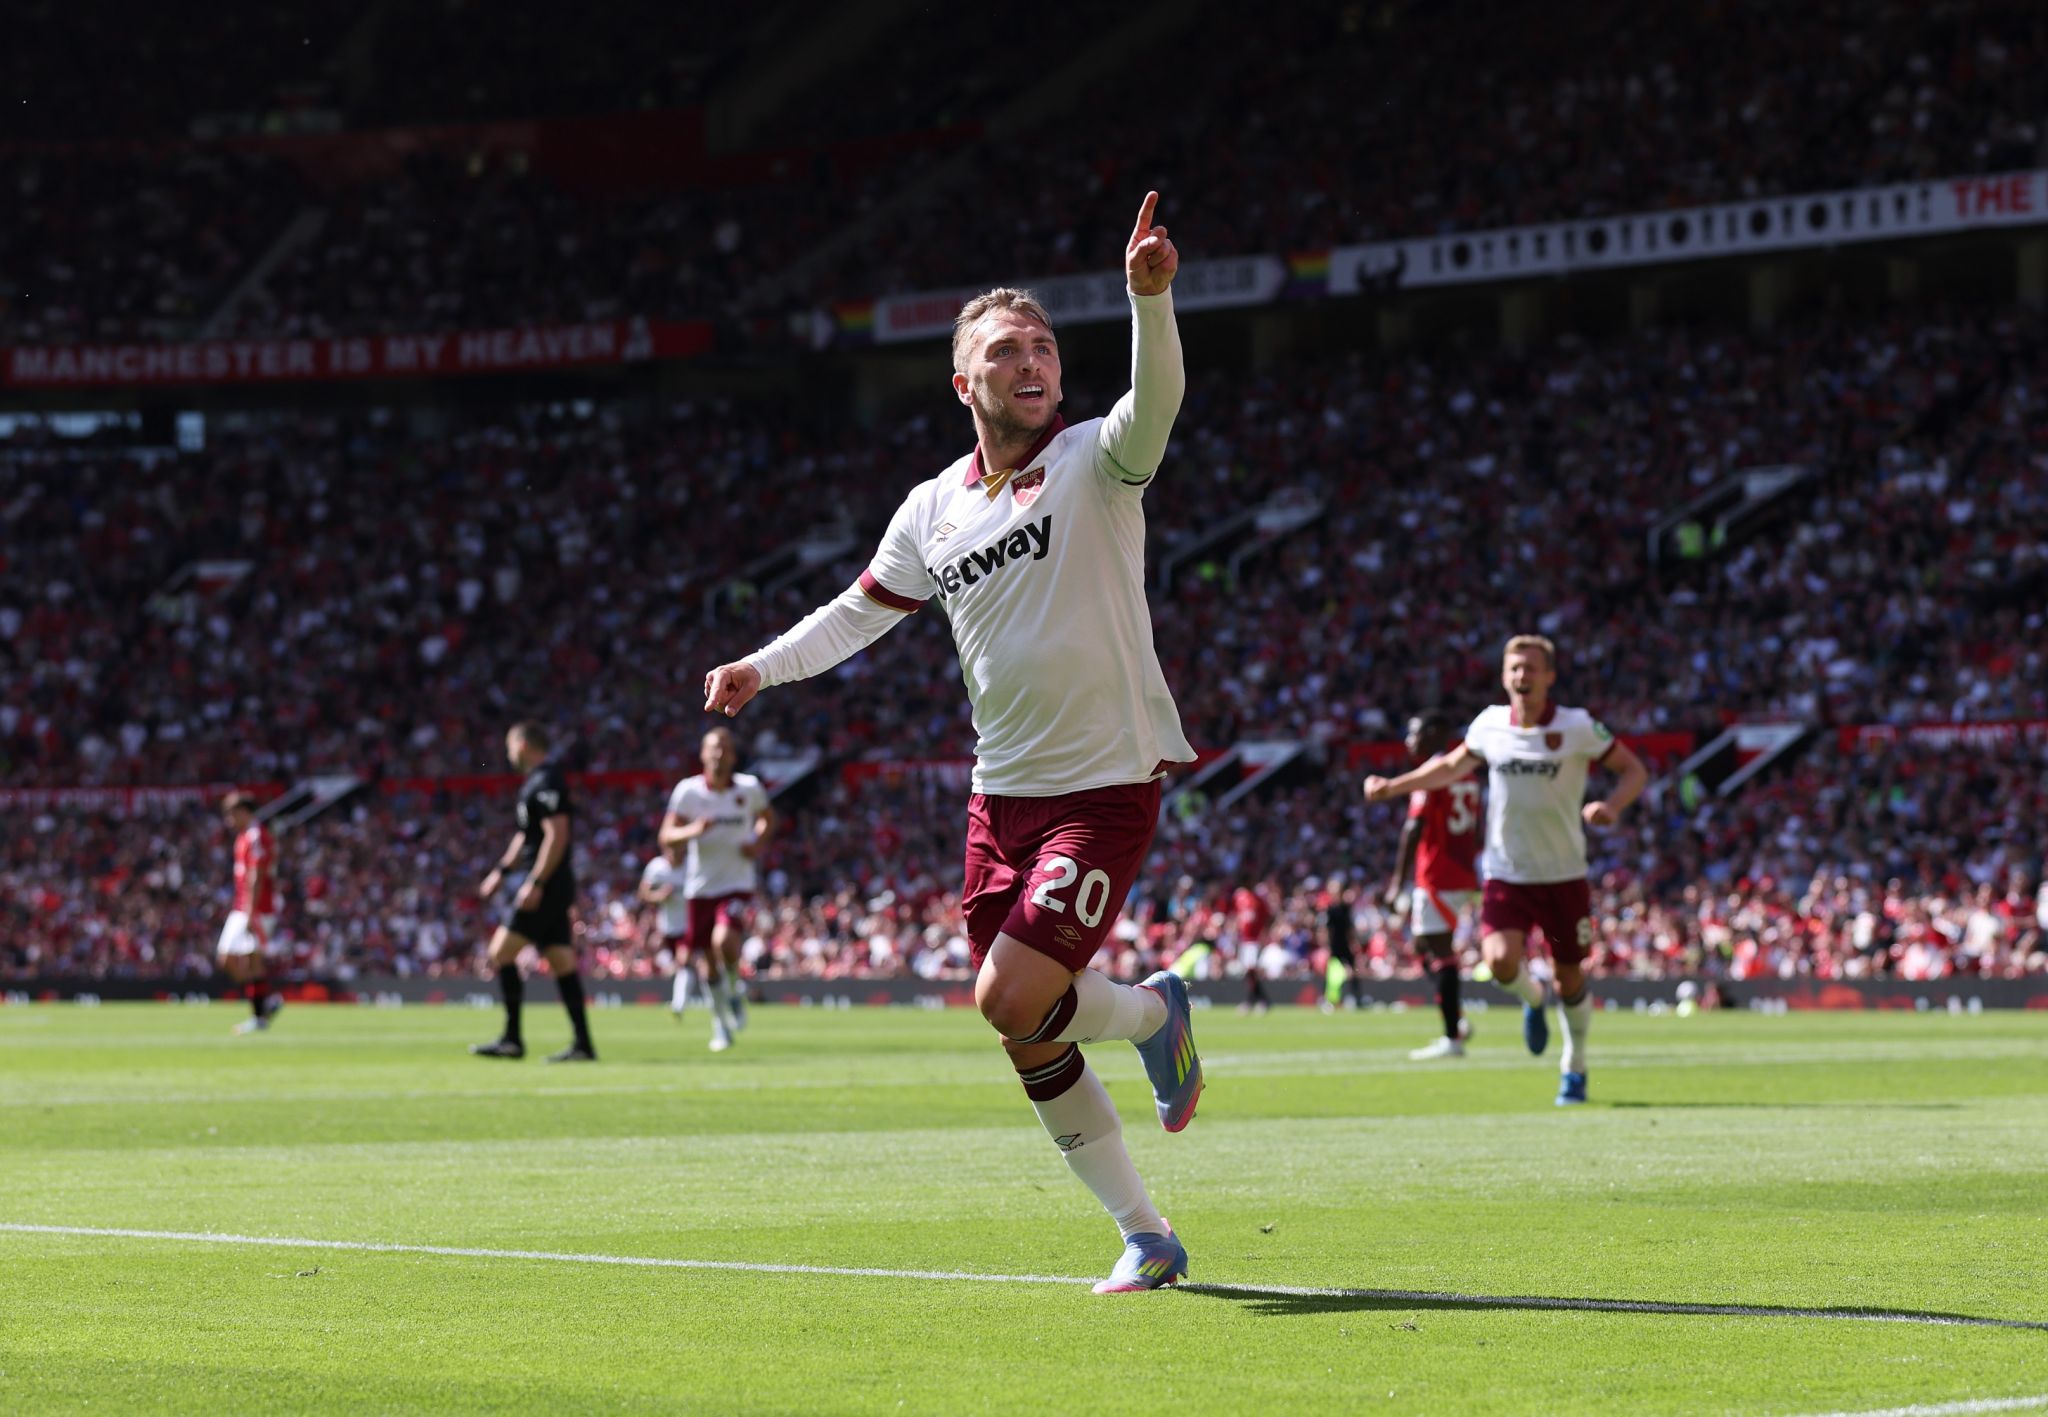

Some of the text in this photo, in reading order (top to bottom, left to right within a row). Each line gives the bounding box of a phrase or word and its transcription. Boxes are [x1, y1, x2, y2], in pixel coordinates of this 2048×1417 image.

[1953, 177, 2033, 217] THE
[11, 323, 615, 382] MANCHESTER IS MY HEAVEN
[1496, 757, 1563, 780] etway
[1030, 856, 1110, 928] 20
